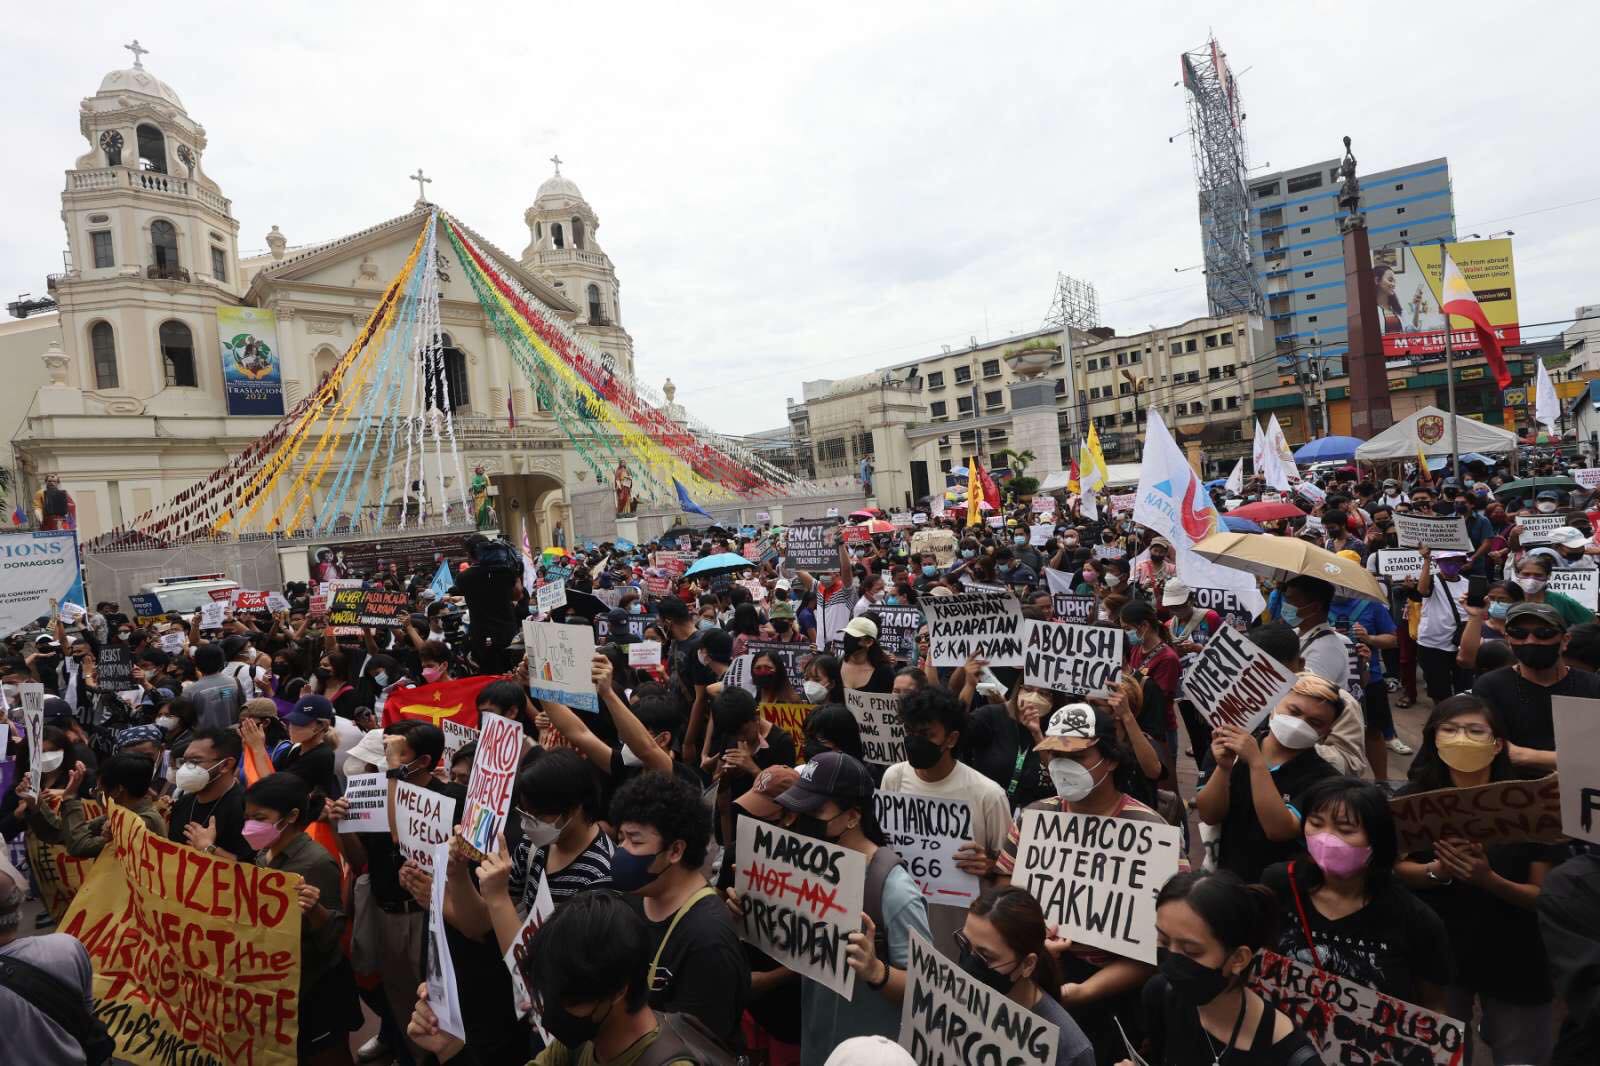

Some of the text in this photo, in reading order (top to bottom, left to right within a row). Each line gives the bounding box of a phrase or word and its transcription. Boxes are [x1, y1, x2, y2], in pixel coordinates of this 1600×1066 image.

[1463, 265, 1483, 273] Wallet
[1484, 263, 1509, 271] account
[227, 386, 283, 395] TRASLACION
[245, 392, 268, 401] 2022
[788, 526, 824, 542] ENACT
[1524, 524, 1541, 532] AND
[0, 541, 63, 558] IONS
[4, 558, 64, 569] DOMAGOSO
[1384, 564, 1438, 572] DEMOCRCY
[1387, 556, 1417, 565] STAND
[1553, 573, 1591, 582] AGAIN
[1545, 582, 1586, 591] ARTIAL
[934, 601, 1009, 620] KABUHAYAN,
[1057, 600, 1094, 617] UPHO
[879, 611, 920, 628] GRADE
[931, 614, 1019, 638] KARAPATAN
[948, 637, 1023, 661] KALAYAAN
[1027, 624, 1116, 659] ABOLISH
[848, 692, 864, 709] ANG
[863, 711, 904, 726] SA EDS
[890, 726, 905, 738] NA
[473, 718, 521, 773] MARCOS
[354, 789, 381, 799] COMEBACK
[468, 764, 515, 817] DUTERTE
[397, 788, 441, 823] IMELDA
[345, 811, 370, 820] LACKPINK
[872, 793, 973, 841] OPMARCOS2
[884, 833, 942, 850] END TO
[1034, 813, 1172, 855] MARCOS-
[753, 825, 846, 885] MARCOS
[1025, 845, 1147, 890] DUTERTE
[745, 860, 844, 919] NOT MY
[1027, 873, 1141, 945] ITAKWIL
[741, 894, 860, 985] PRESIDENT
[229, 940, 296, 974] the
[911, 938, 1051, 1064] WAFAZIN ANG
[911, 977, 1026, 1066] MARCO
